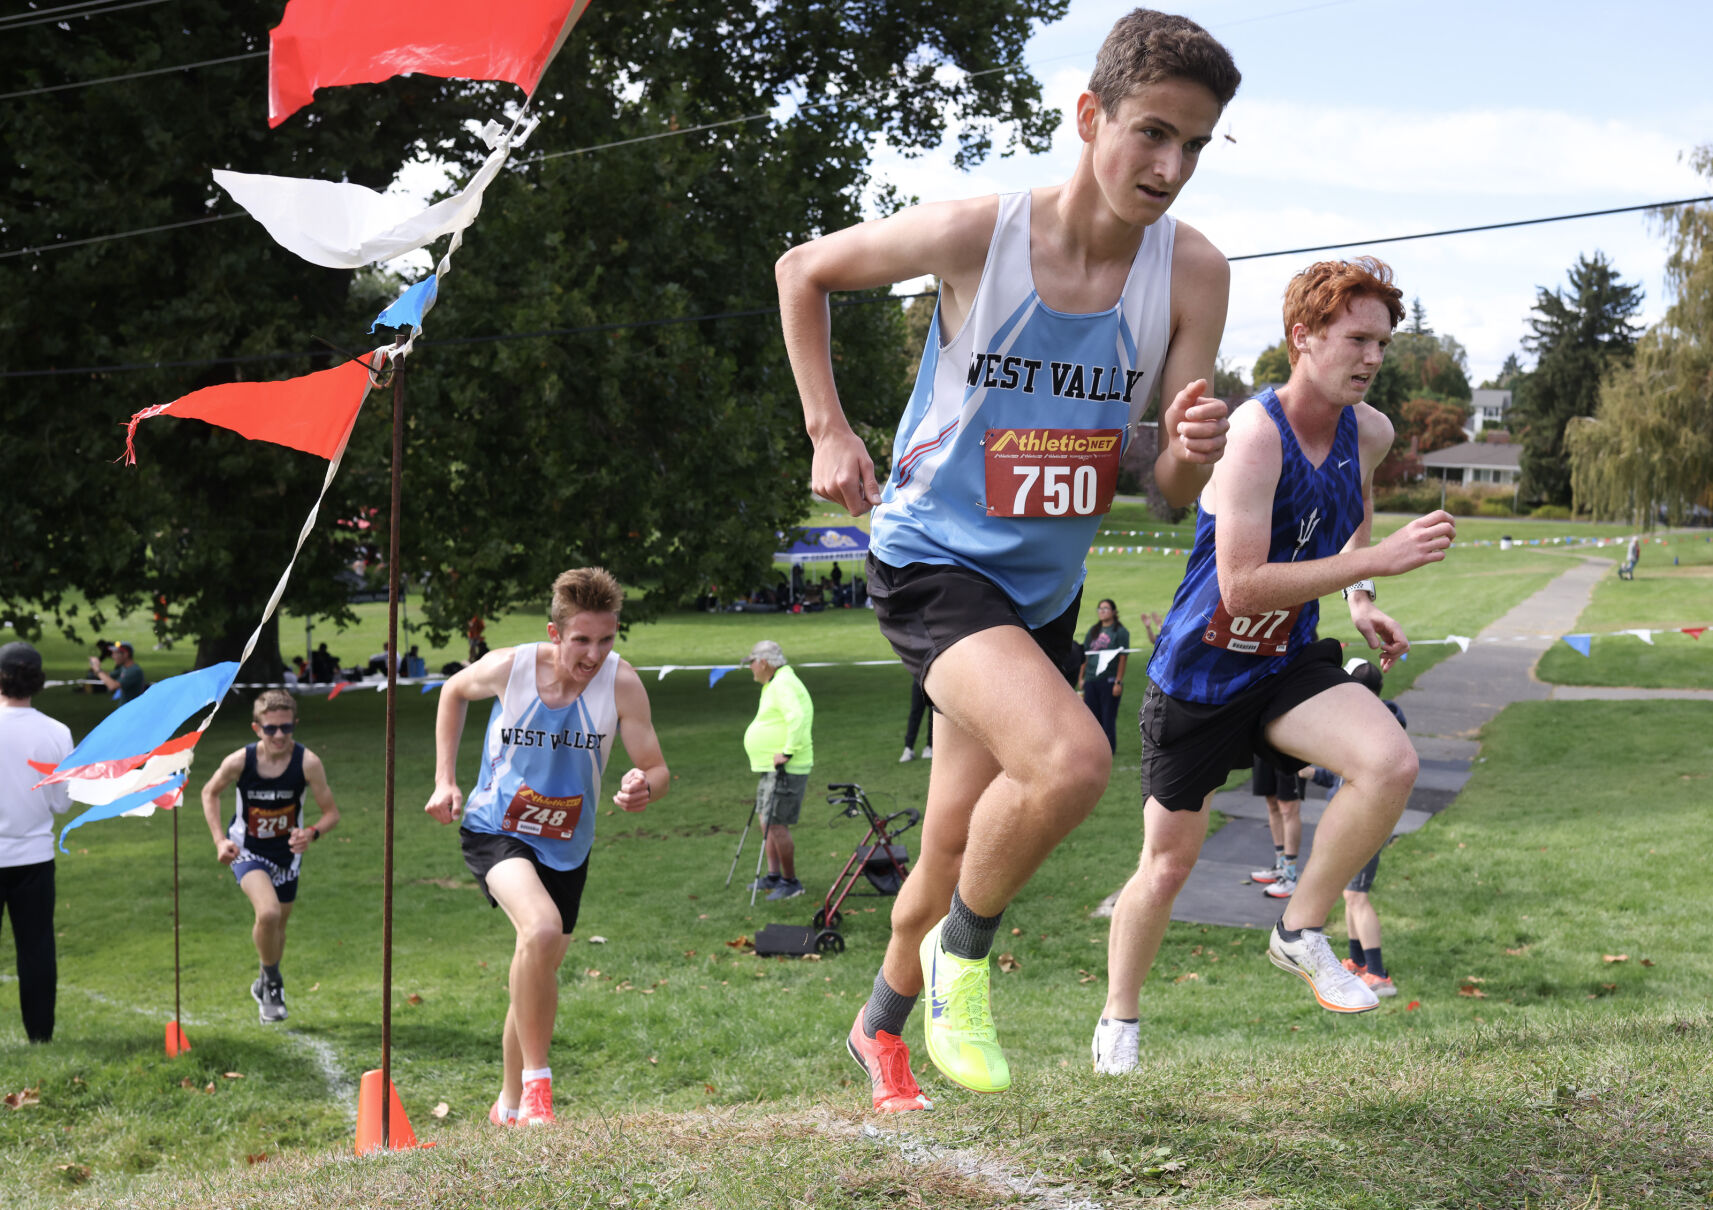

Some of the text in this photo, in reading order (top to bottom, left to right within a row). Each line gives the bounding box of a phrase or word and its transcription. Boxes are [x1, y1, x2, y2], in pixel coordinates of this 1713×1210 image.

[966, 352, 1042, 394] WEST
[1013, 465, 1098, 515] 750
[501, 728, 607, 750] WEST VLLEY
[257, 815, 288, 832] 279
[519, 804, 567, 826] 748
